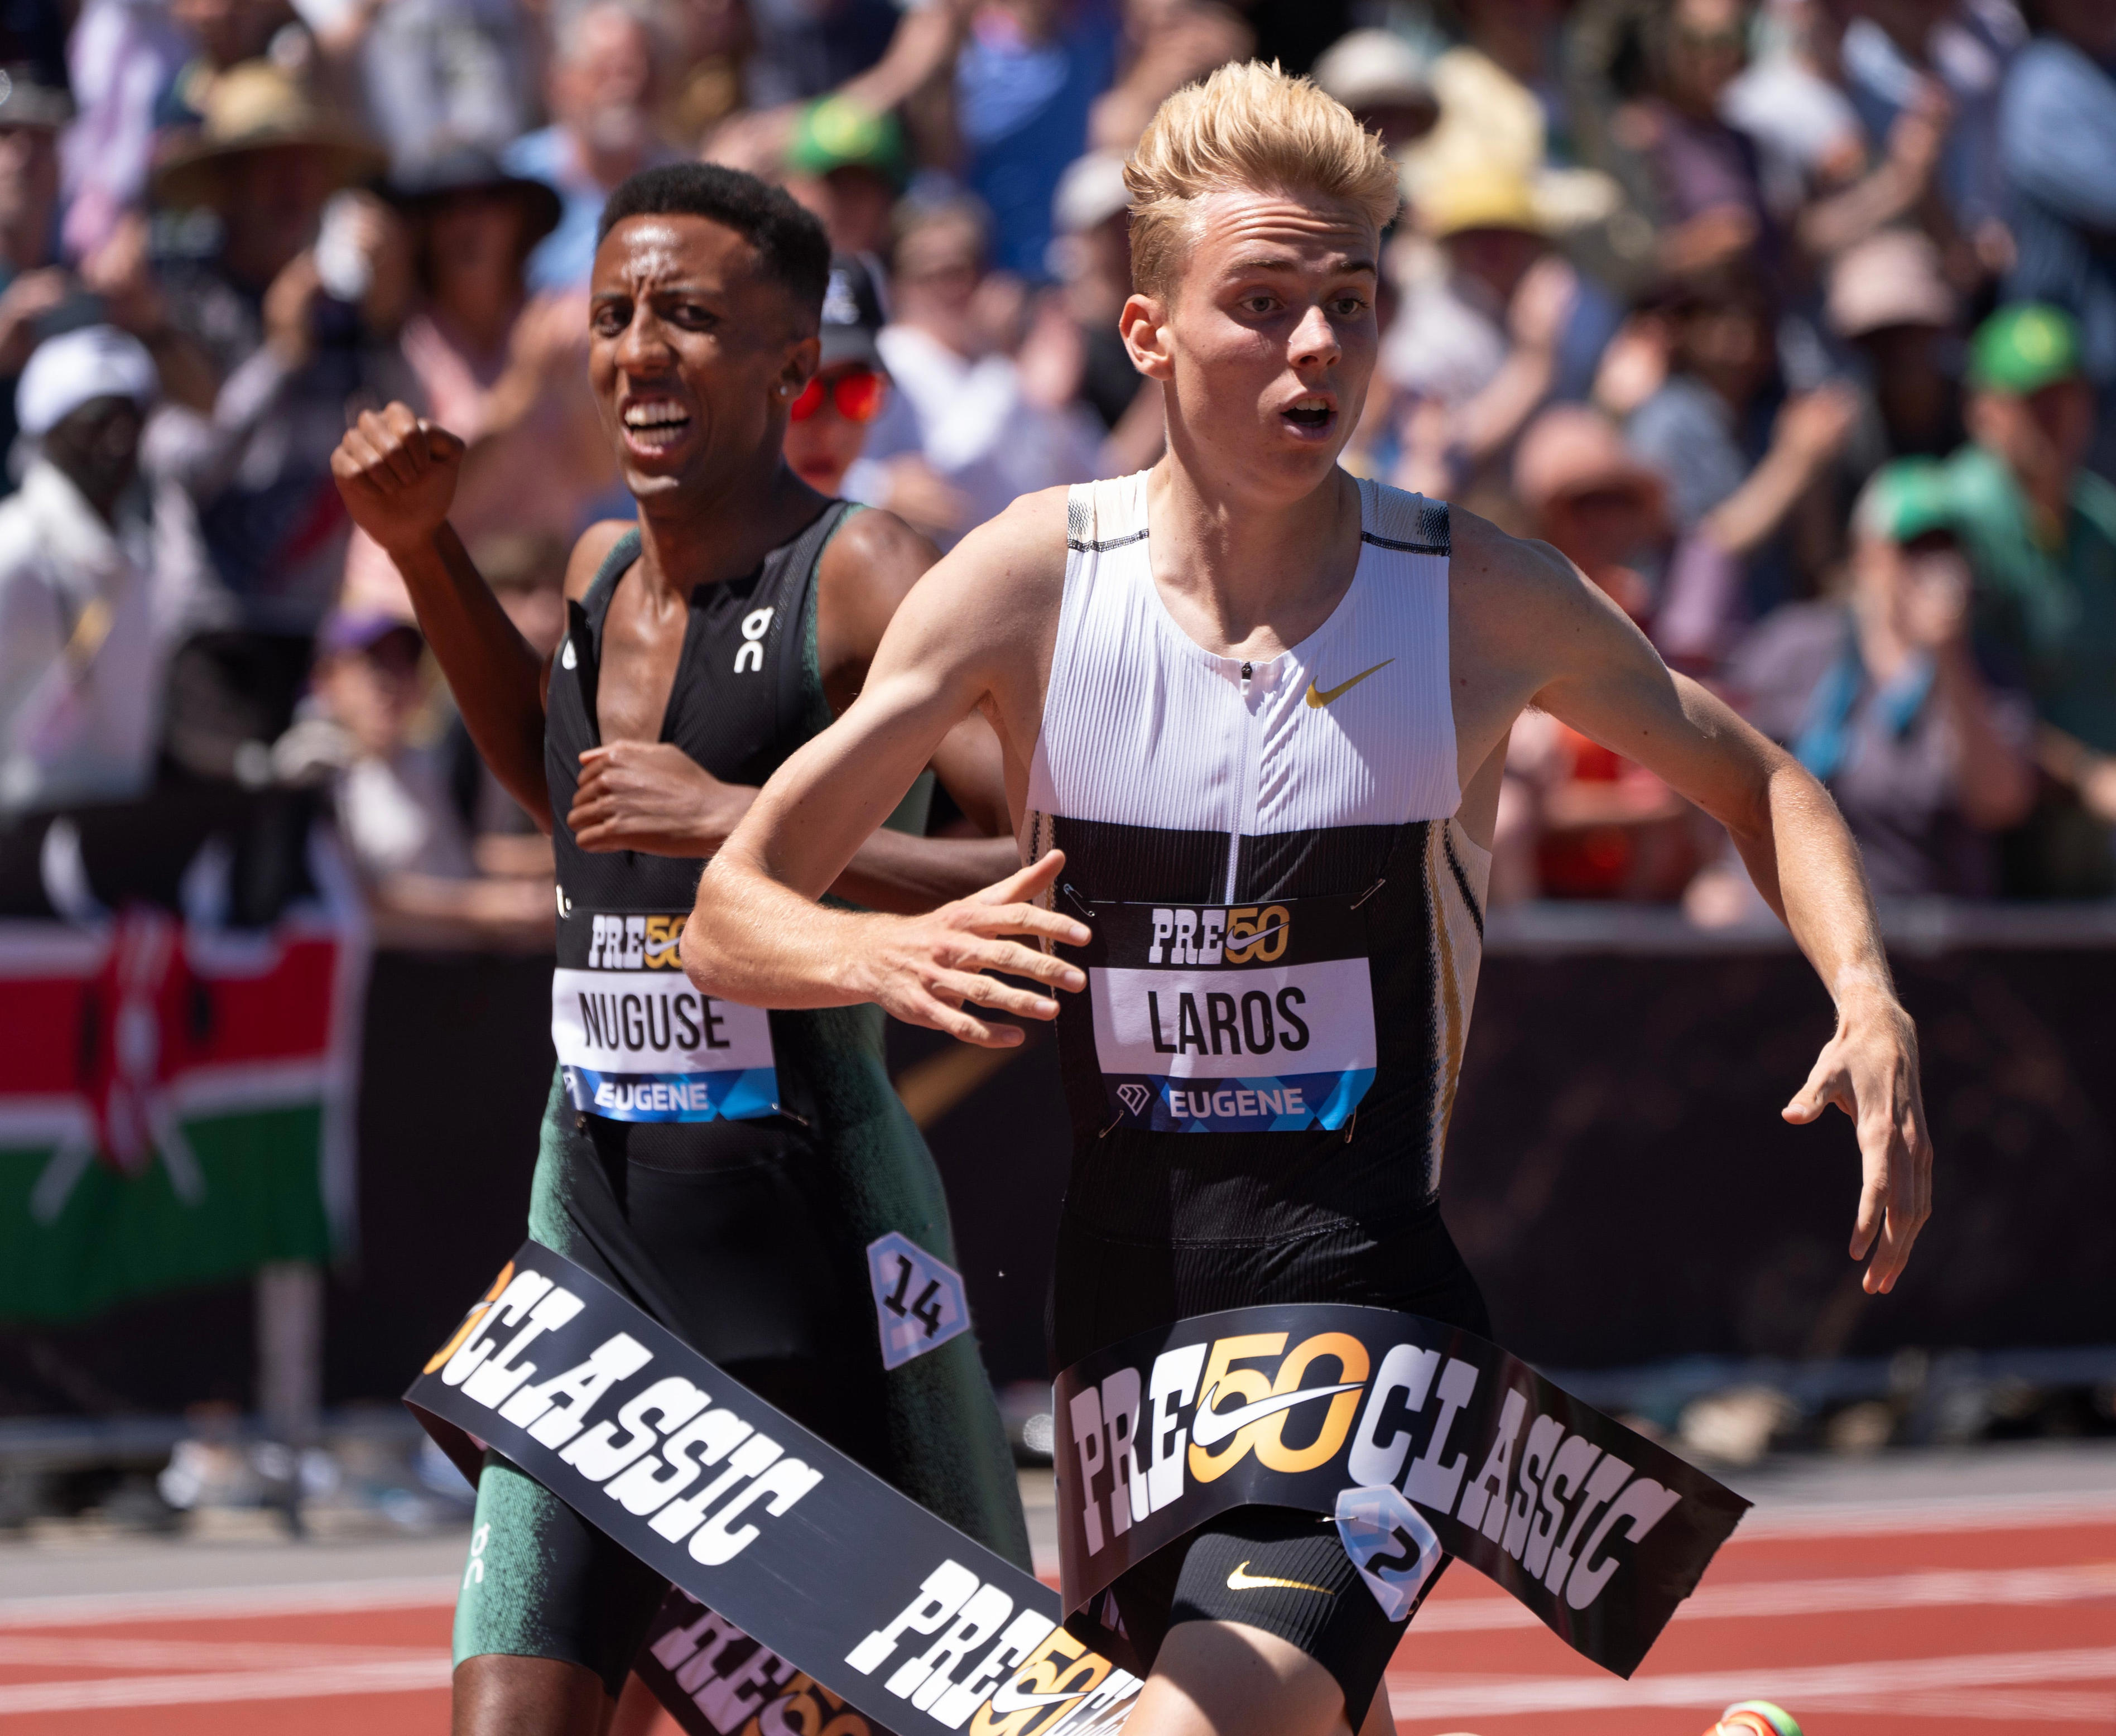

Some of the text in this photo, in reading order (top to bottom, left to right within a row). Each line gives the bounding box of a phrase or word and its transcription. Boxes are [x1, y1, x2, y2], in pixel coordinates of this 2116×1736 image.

[578, 992, 730, 1053] NUGUSE
[1147, 987, 1310, 1056] LAROS
[594, 1081, 709, 1112] EUGENE
[1169, 1088, 1306, 1119] EUGENE
[883, 1253, 943, 1340] 14
[441, 1269, 824, 1566] CLASSIC
[1348, 1343, 1682, 1610] CLASSIC
[1364, 1525, 1421, 1583] 2
